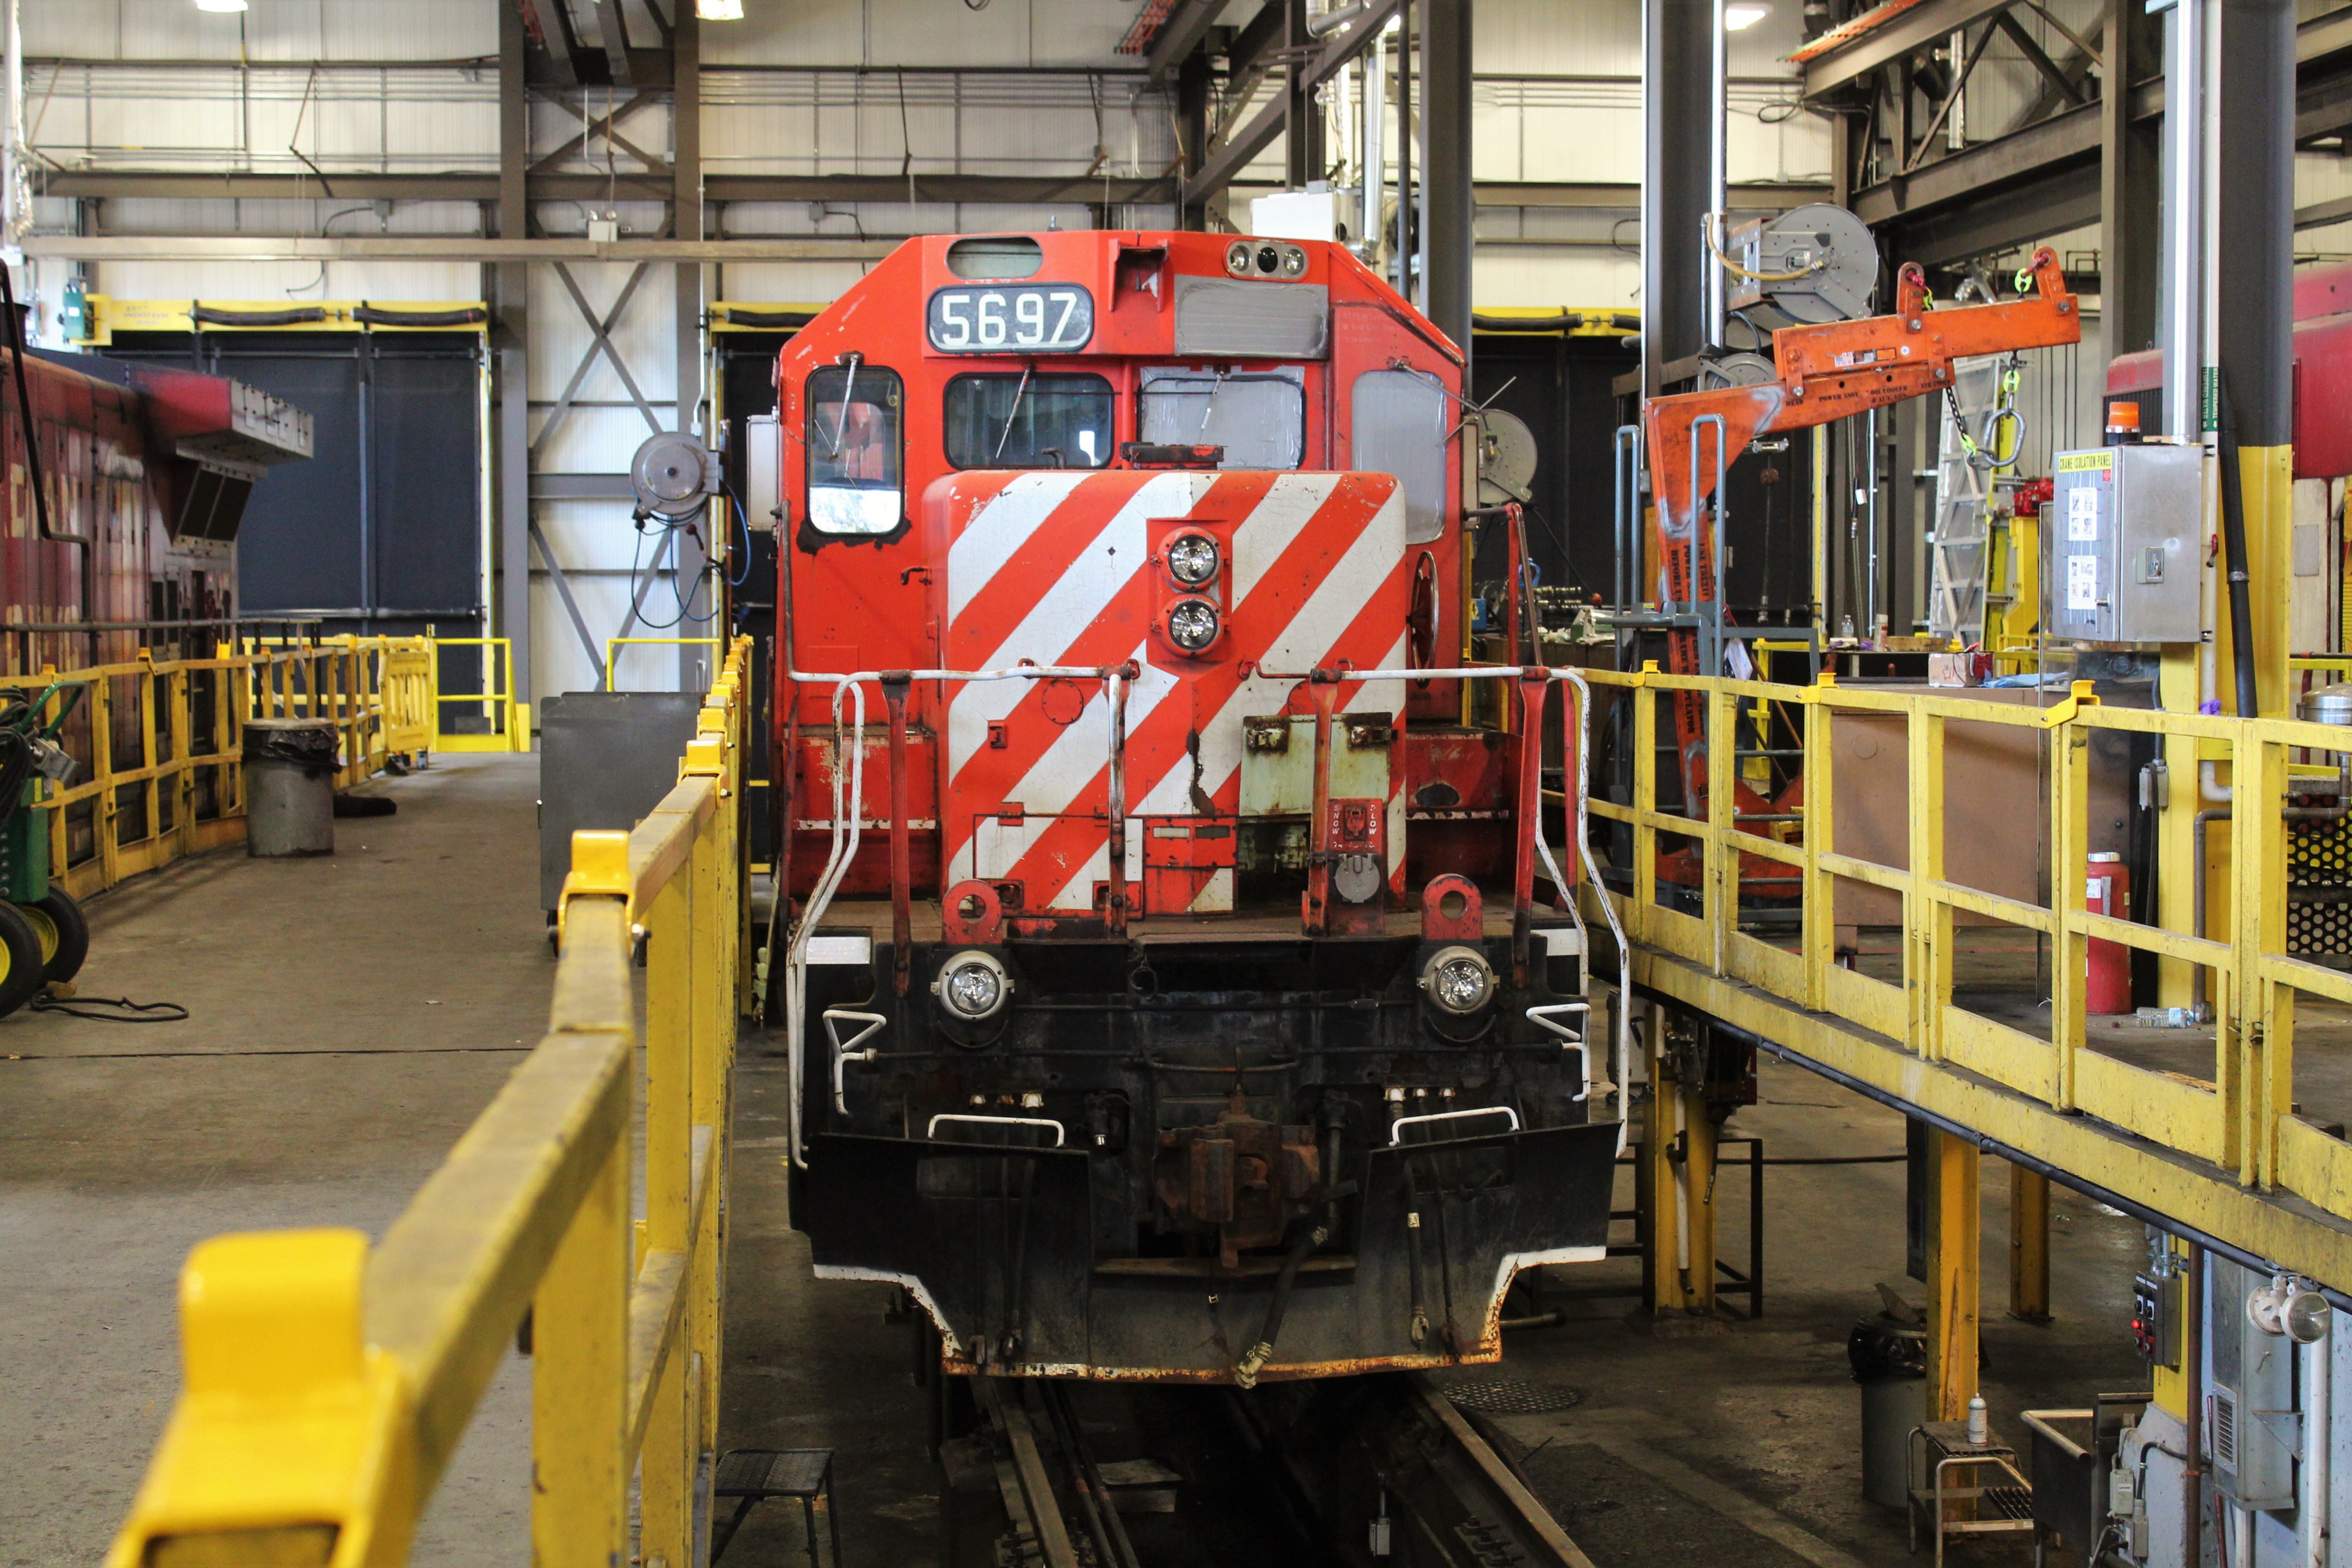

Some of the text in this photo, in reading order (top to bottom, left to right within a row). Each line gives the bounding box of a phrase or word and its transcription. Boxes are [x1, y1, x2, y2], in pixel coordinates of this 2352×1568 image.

[942, 292, 1077, 345] 5697
[1785, 398, 1804, 407] HEAD
[2059, 454, 2111, 470] CRANE ISOLATION PANEL
